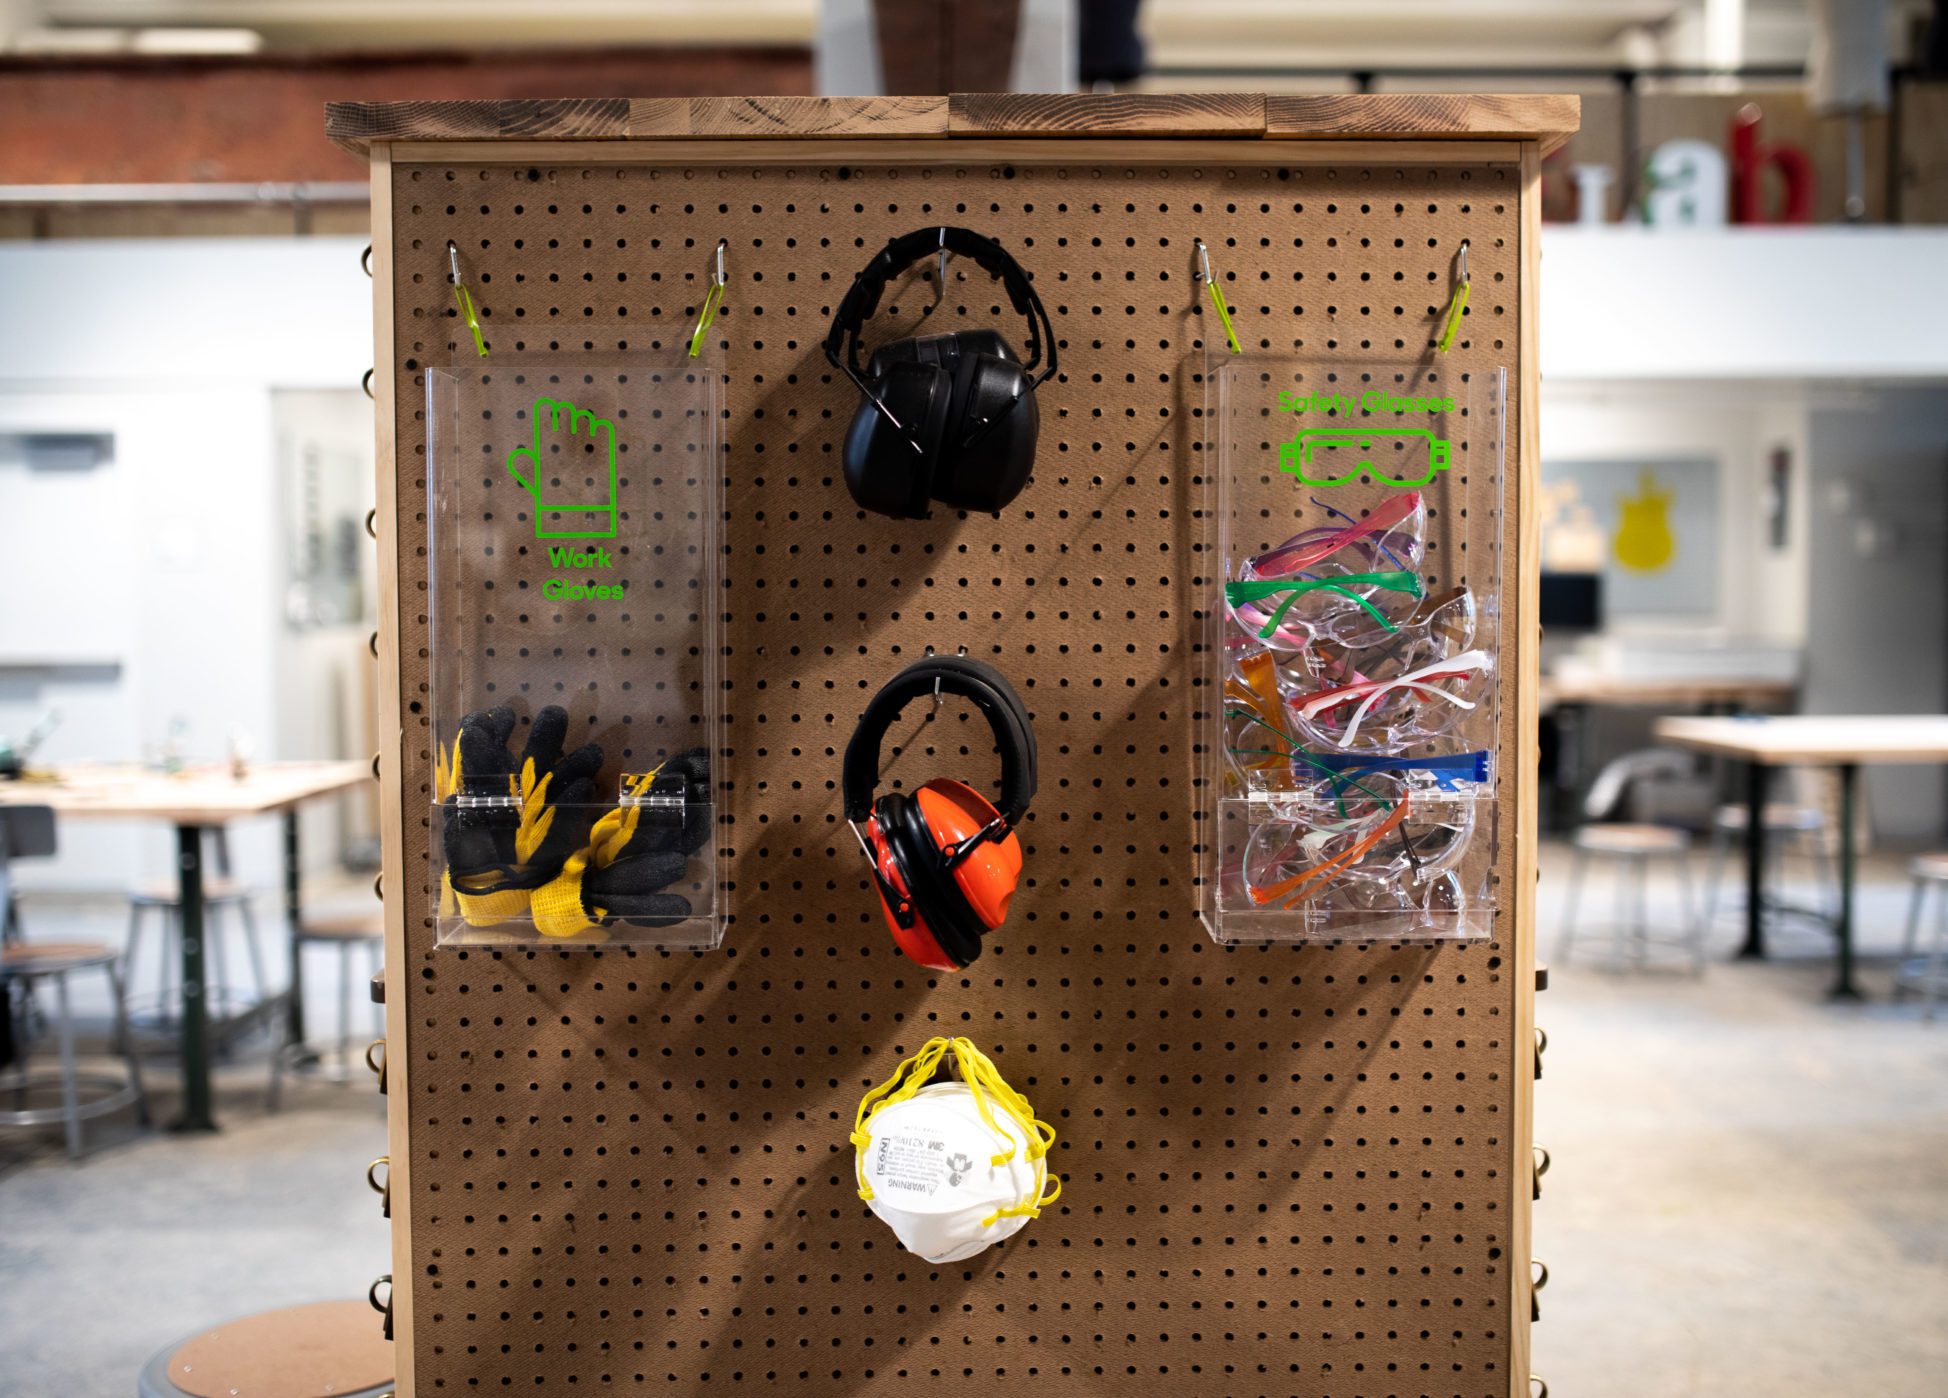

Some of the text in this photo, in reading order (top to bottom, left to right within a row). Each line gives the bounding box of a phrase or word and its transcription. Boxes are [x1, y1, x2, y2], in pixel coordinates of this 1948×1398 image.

[1279, 390, 1455, 417] Safety Glasses
[548, 546, 612, 568] Work
[543, 579, 624, 600] Gloves
[928, 1140, 944, 1151] 3M
[878, 1141, 888, 1172] N95
[888, 1178, 926, 1192] WARNING
